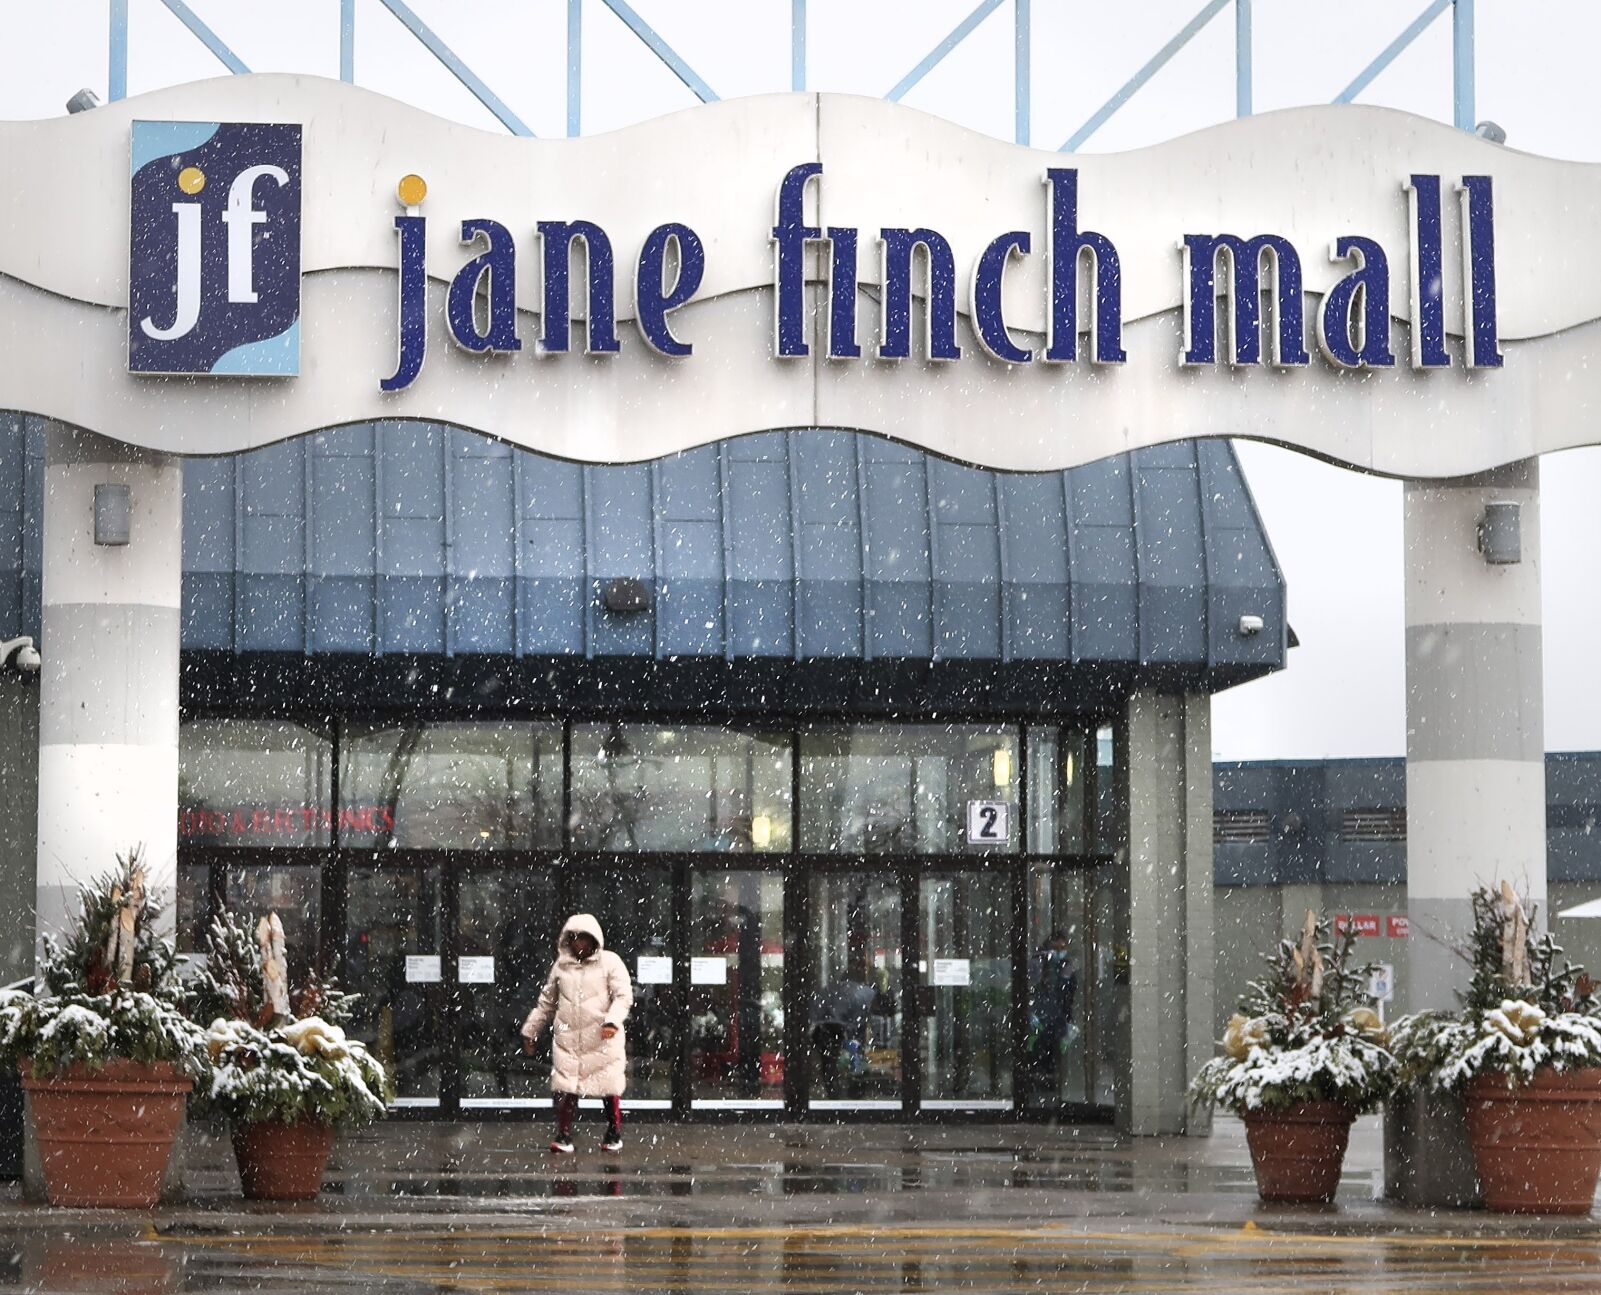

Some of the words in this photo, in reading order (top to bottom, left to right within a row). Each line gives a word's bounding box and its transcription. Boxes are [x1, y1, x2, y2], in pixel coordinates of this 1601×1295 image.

[140, 163, 290, 341] jf
[379, 173, 706, 392] jane
[770, 162, 1127, 364] finch
[1177, 173, 1505, 369] mall
[979, 806, 998, 838] 2
[1337, 919, 1377, 932] DLLAR
